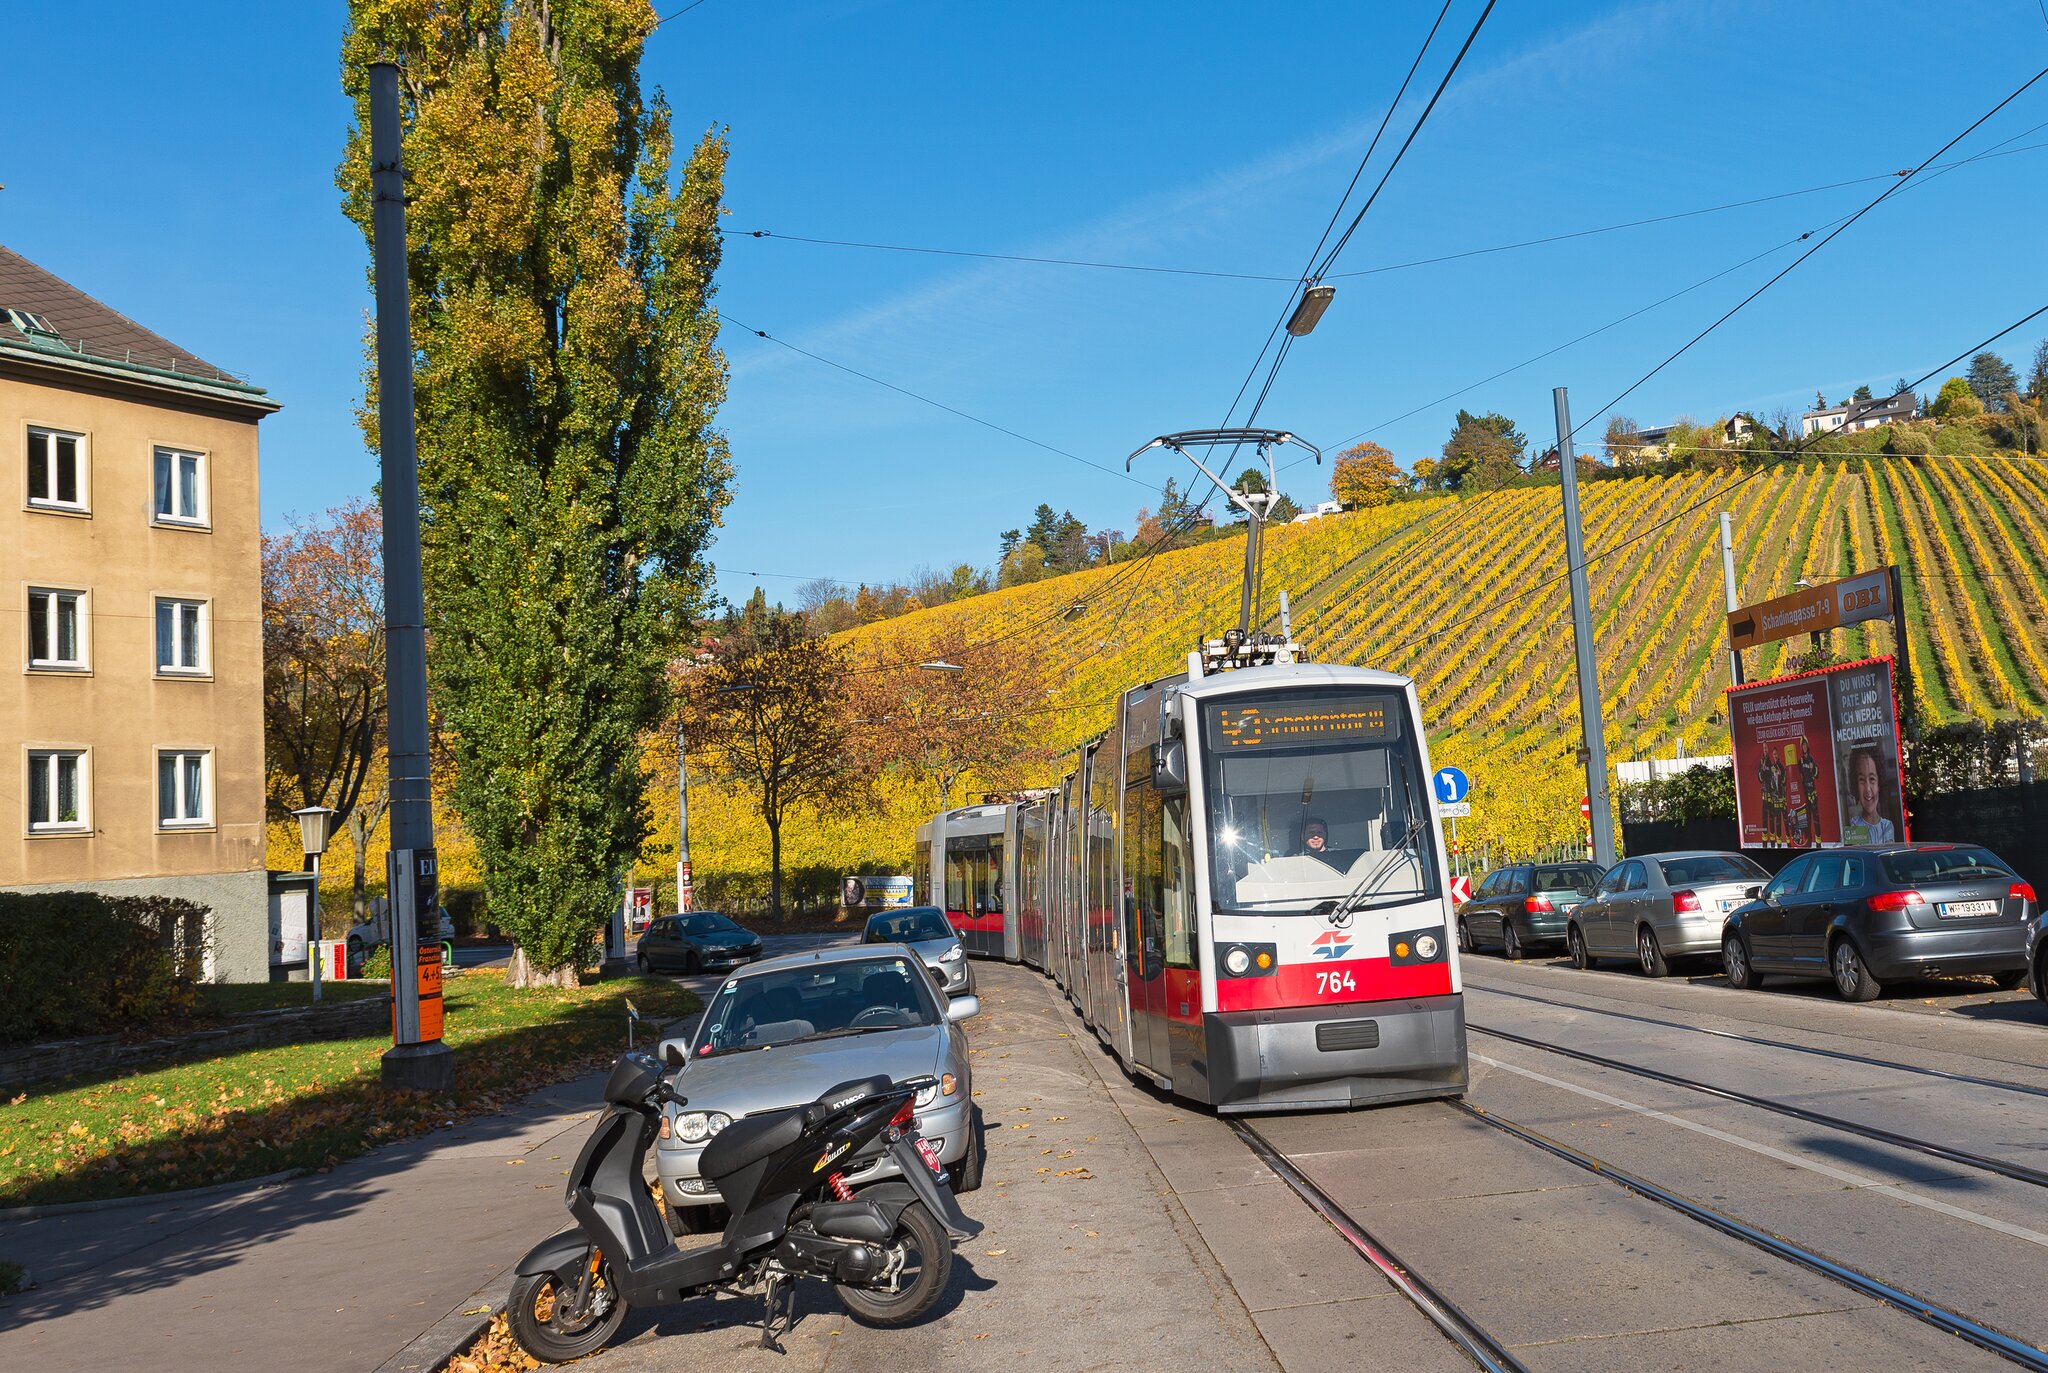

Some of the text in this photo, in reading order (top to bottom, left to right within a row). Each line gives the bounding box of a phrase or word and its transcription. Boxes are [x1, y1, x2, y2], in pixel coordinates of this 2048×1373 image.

[1843, 585, 1881, 612] OBI
[1762, 598, 1830, 630] Schadinagasse 7-9
[1840, 673, 1876, 692] DU WIRST
[1842, 690, 1878, 708] PATE UND
[1747, 714, 1755, 725] wie
[1841, 707, 1882, 725] ICH WERDE
[1837, 722, 1890, 742] MECHANIKERIN
[1316, 970, 1356, 995] 764
[832, 1093, 866, 1110] KYMCO
